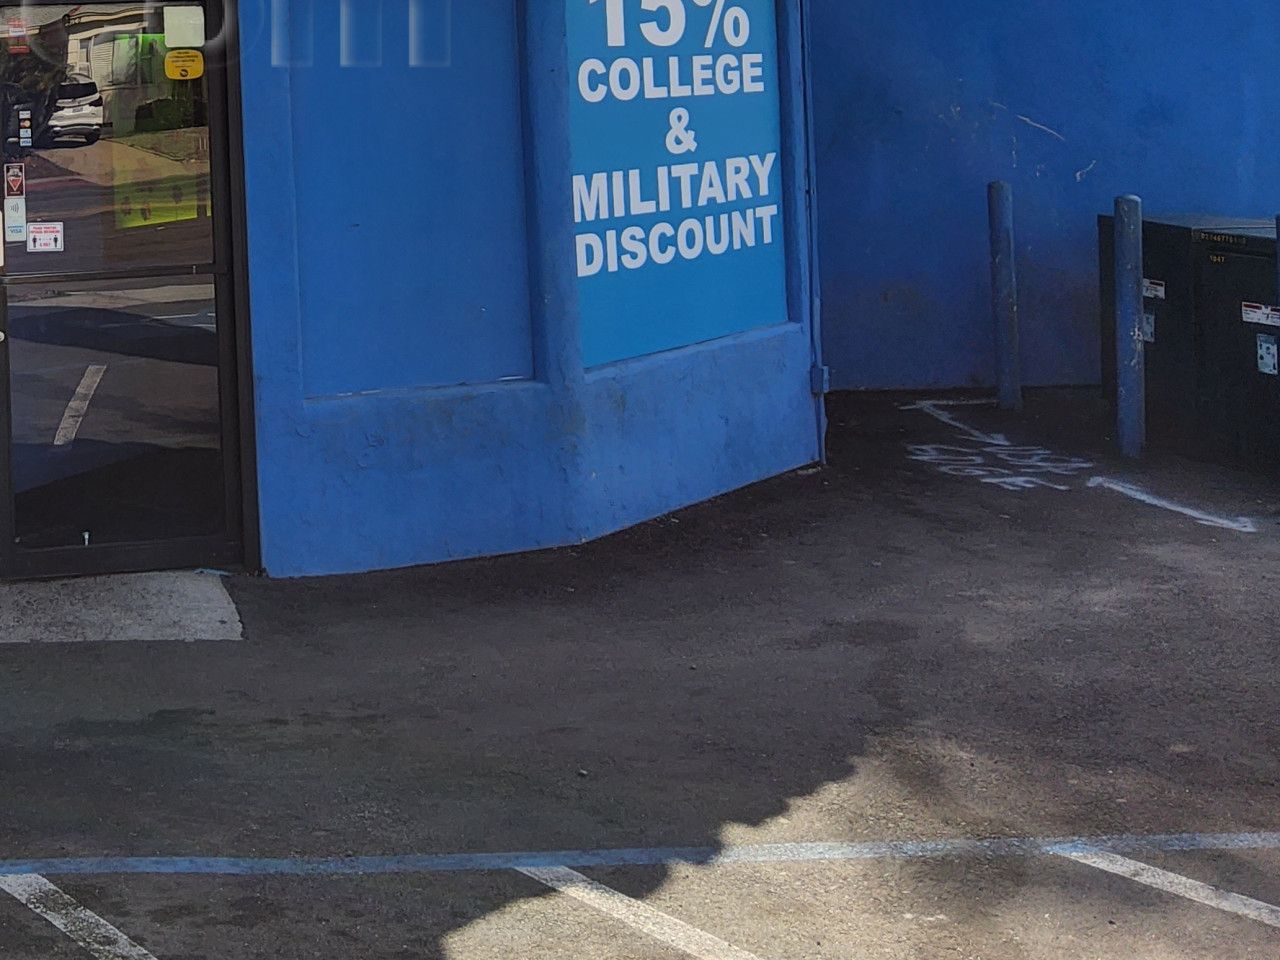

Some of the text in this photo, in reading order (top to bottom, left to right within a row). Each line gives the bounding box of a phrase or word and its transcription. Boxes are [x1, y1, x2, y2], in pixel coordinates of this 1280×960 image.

[578, 54, 765, 103] COLLEGE
[665, 107, 698, 154] &
[572, 152, 777, 223] MILITARY
[575, 204, 778, 277] DISCOUNT
